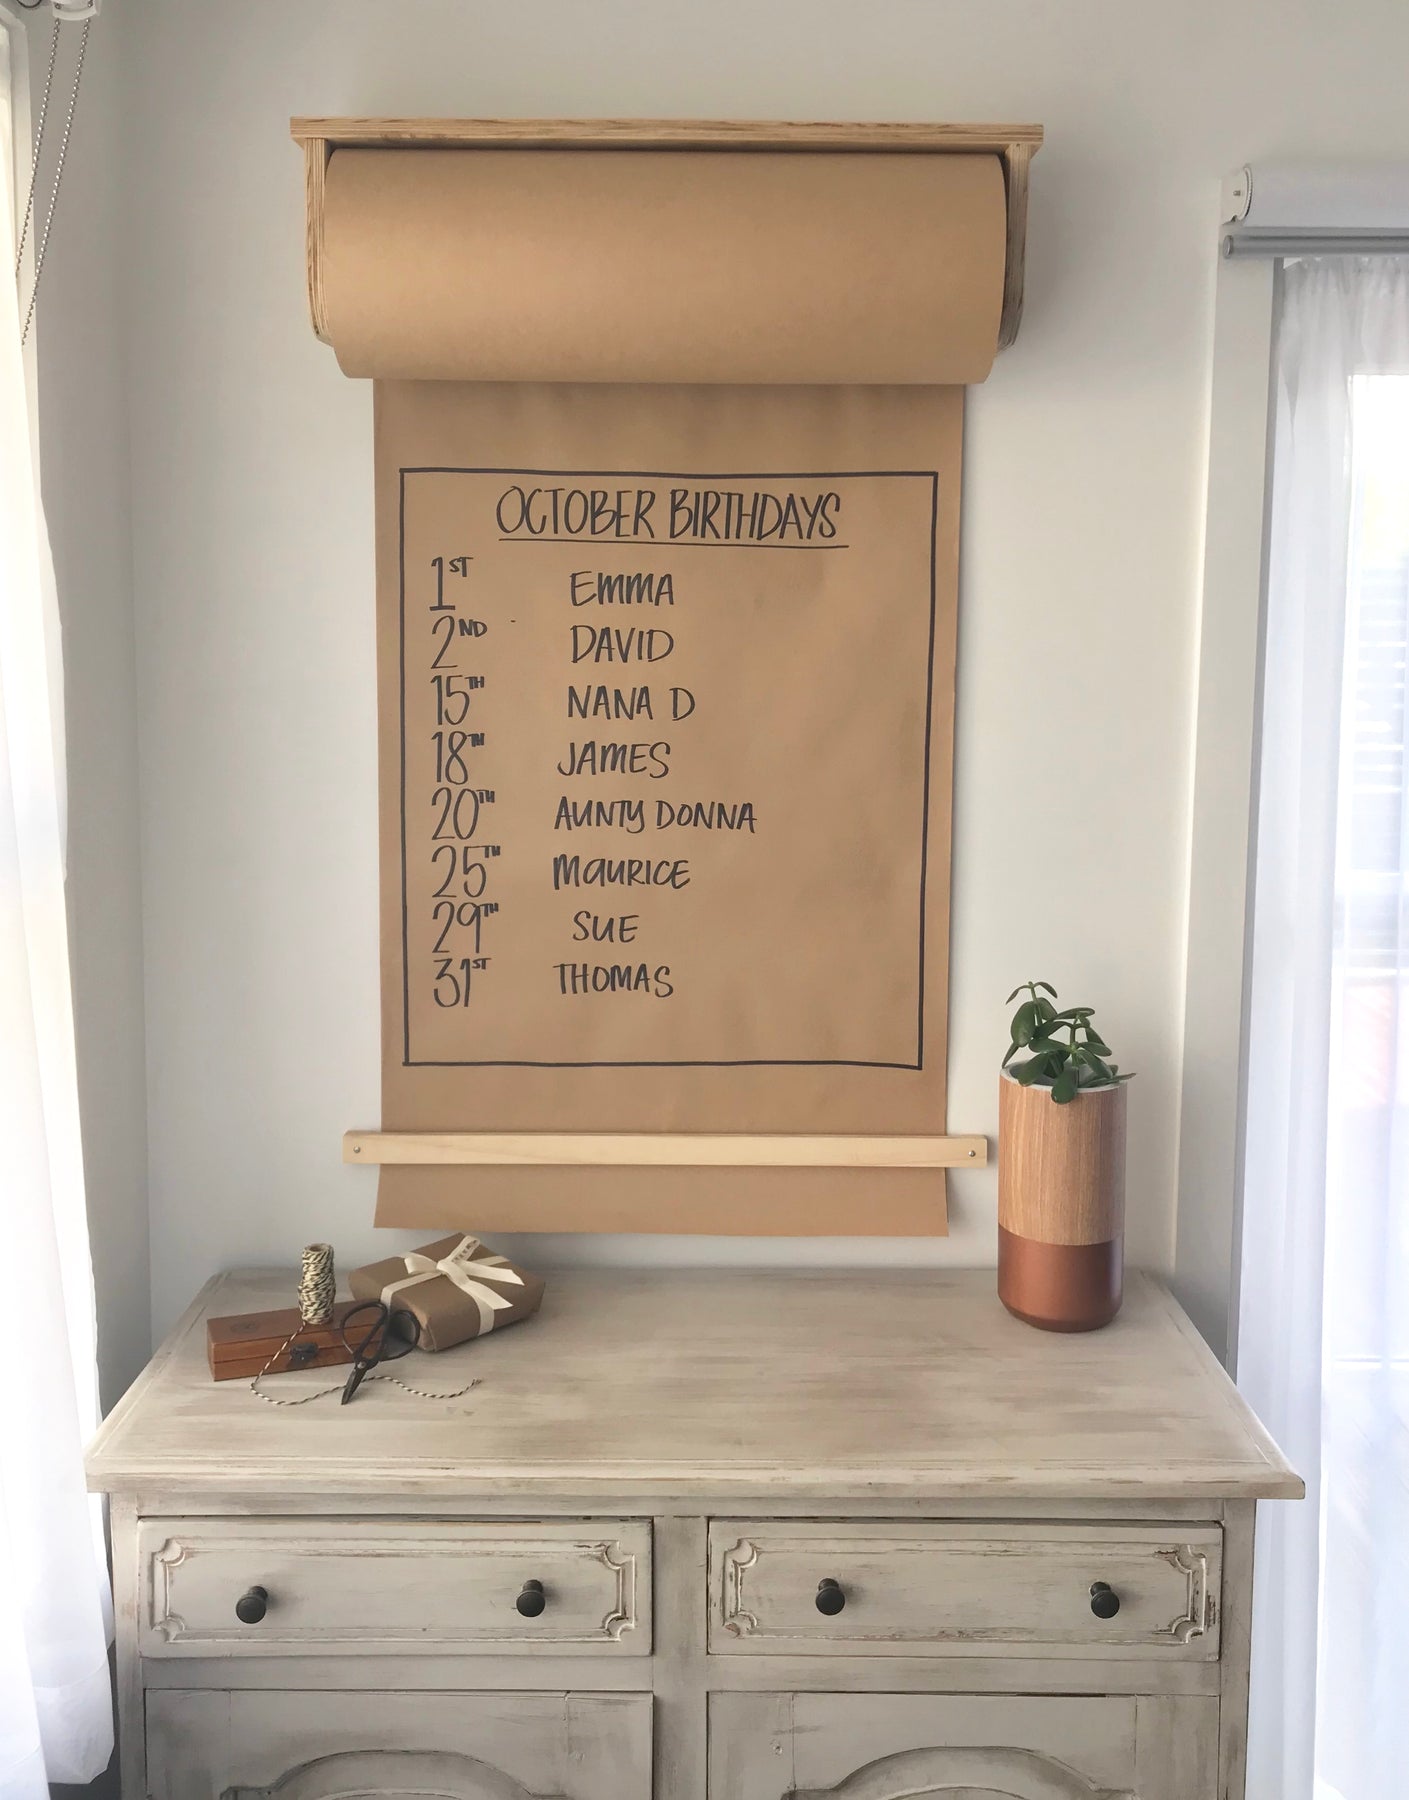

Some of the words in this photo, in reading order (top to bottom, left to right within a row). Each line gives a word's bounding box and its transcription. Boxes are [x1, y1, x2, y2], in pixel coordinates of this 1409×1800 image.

[496, 485, 656, 539] OCTOBER
[669, 488, 841, 541] BIRTHDAYS
[569, 570, 675, 607] EMMA
[569, 624, 674, 664] DAVID
[567, 684, 654, 721] NANA
[668, 687, 696, 722] D
[556, 740, 671, 779] JAMES
[553, 795, 646, 834] AUNTY
[655, 800, 758, 834] DONNA
[572, 910, 640, 943] SUE
[552, 963, 674, 998] THOMAS
